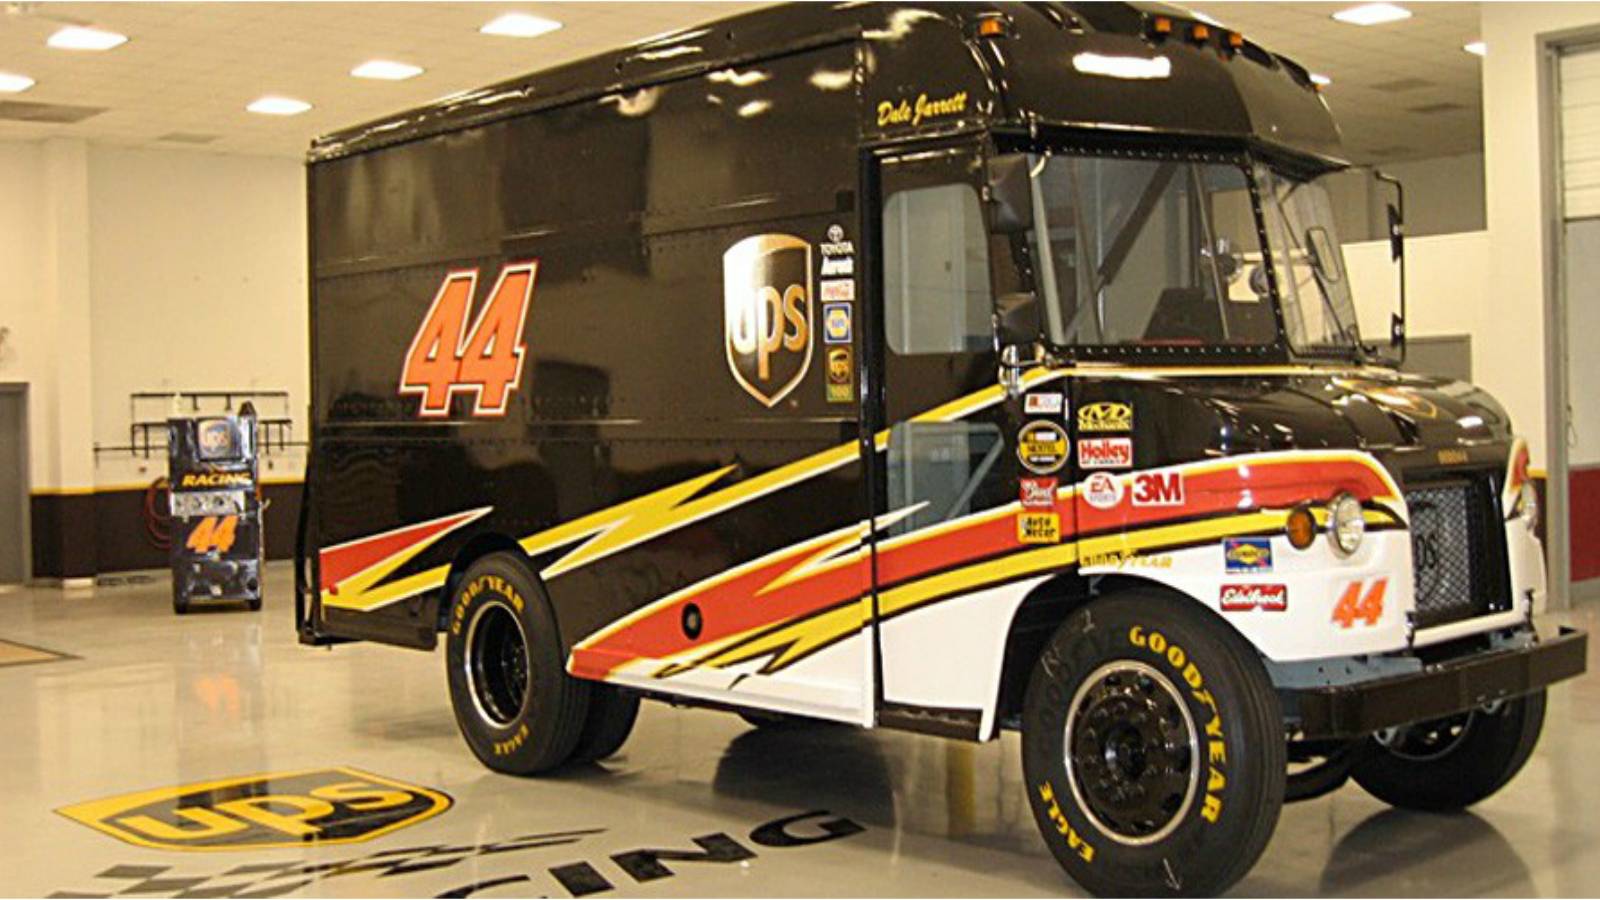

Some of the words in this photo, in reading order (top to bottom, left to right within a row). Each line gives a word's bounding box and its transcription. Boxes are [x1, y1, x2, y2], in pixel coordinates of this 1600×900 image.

[877, 100, 912, 126] Dale
[912, 91, 968, 127] Jarrett
[820, 241, 856, 256] TOYOTA
[399, 251, 539, 417] 44
[1081, 440, 1130, 464] Holley
[182, 472, 253, 487] RACING
[1090, 475, 1115, 493] EA
[1134, 472, 1182, 503] 3M
[186, 515, 239, 554] 44
[1026, 516, 1052, 527] Auto
[452, 575, 525, 635] GOODYEAR
[1331, 576, 1389, 629] 44
[1129, 625, 1226, 824] GOODYEAR
[1038, 780, 1095, 864] EAGLE
